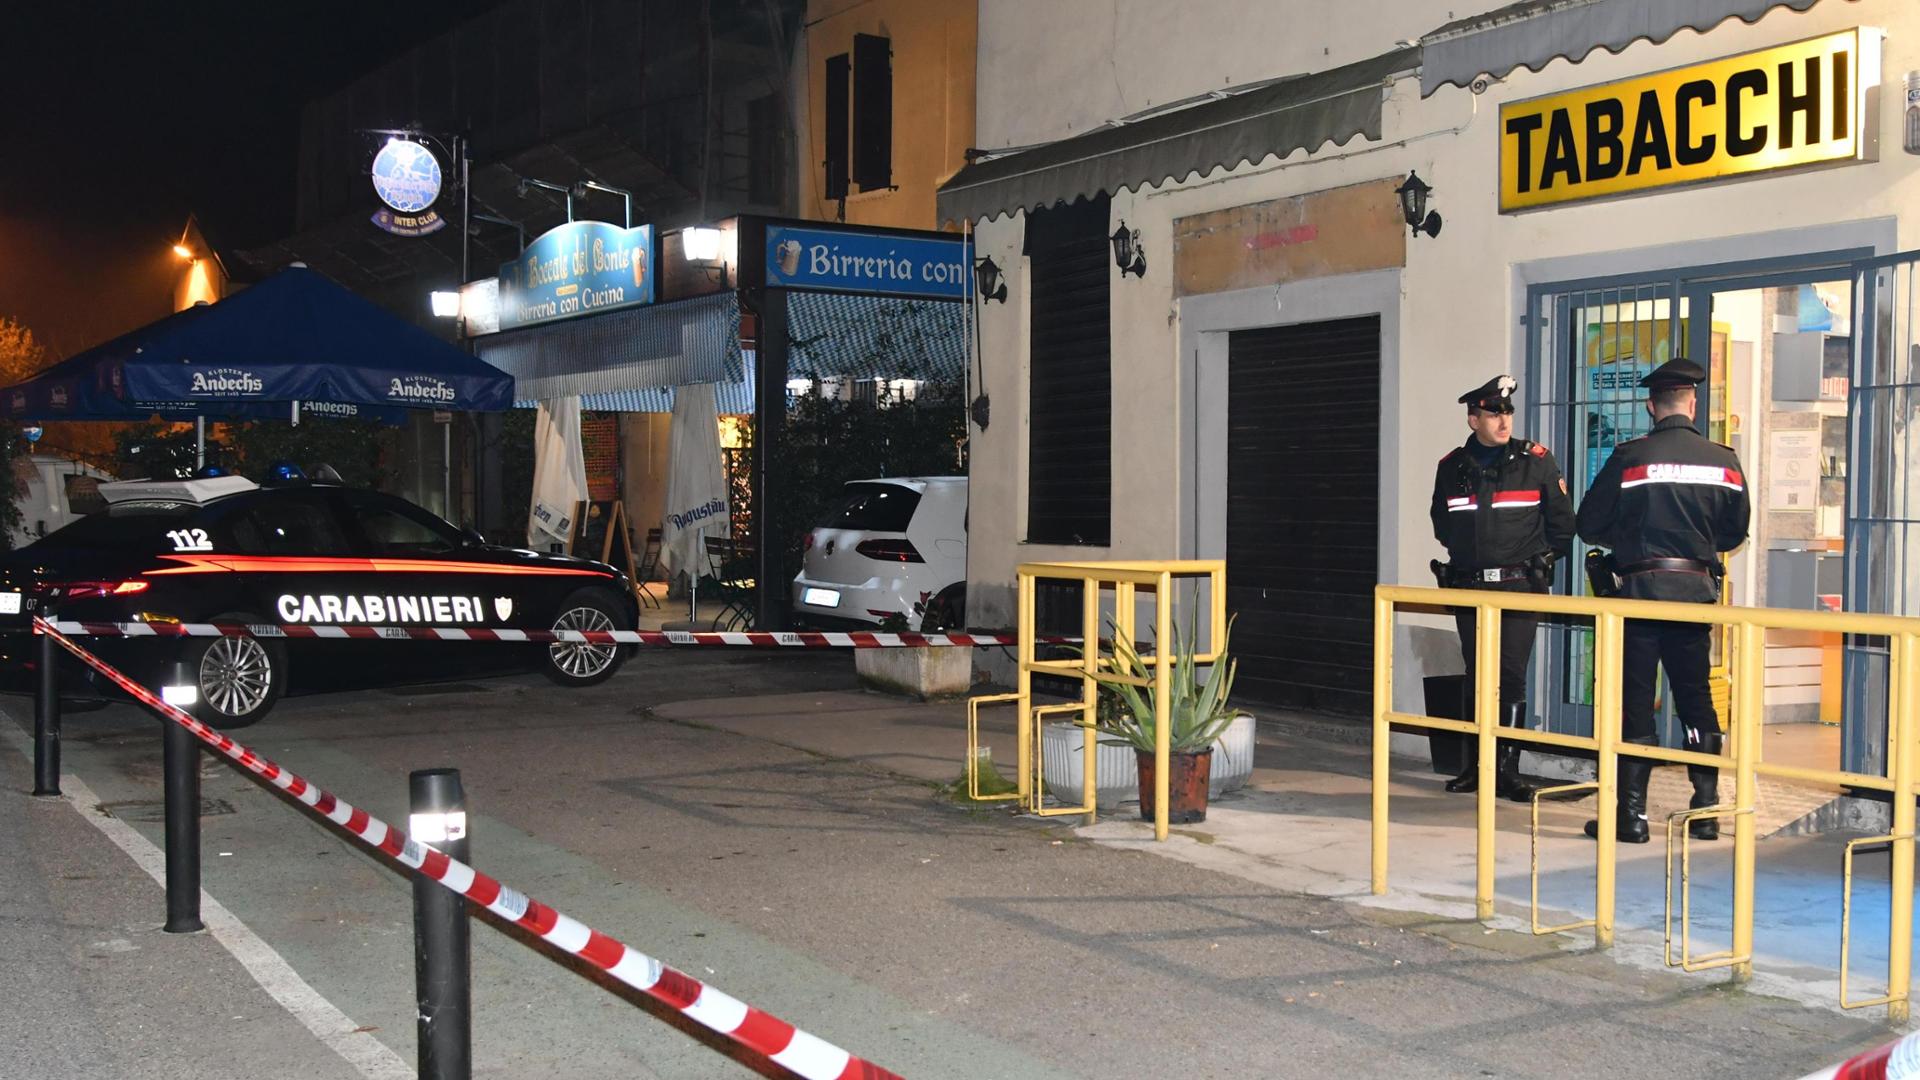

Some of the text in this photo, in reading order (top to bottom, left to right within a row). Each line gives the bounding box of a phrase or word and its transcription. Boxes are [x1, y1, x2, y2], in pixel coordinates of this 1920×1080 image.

[1506, 51, 1848, 194] TABACCHI
[394, 211, 438, 227] INTER CLUB
[809, 244, 912, 280] Birreria
[922, 261, 963, 284] con
[517, 297, 556, 321] Birreria
[560, 296, 579, 313] con
[582, 284, 624, 309] Cucina
[191, 372, 262, 392] Andechs
[388, 377, 455, 401] Andechs
[166, 528, 213, 548] 112
[278, 594, 484, 622] CARABINIERI
